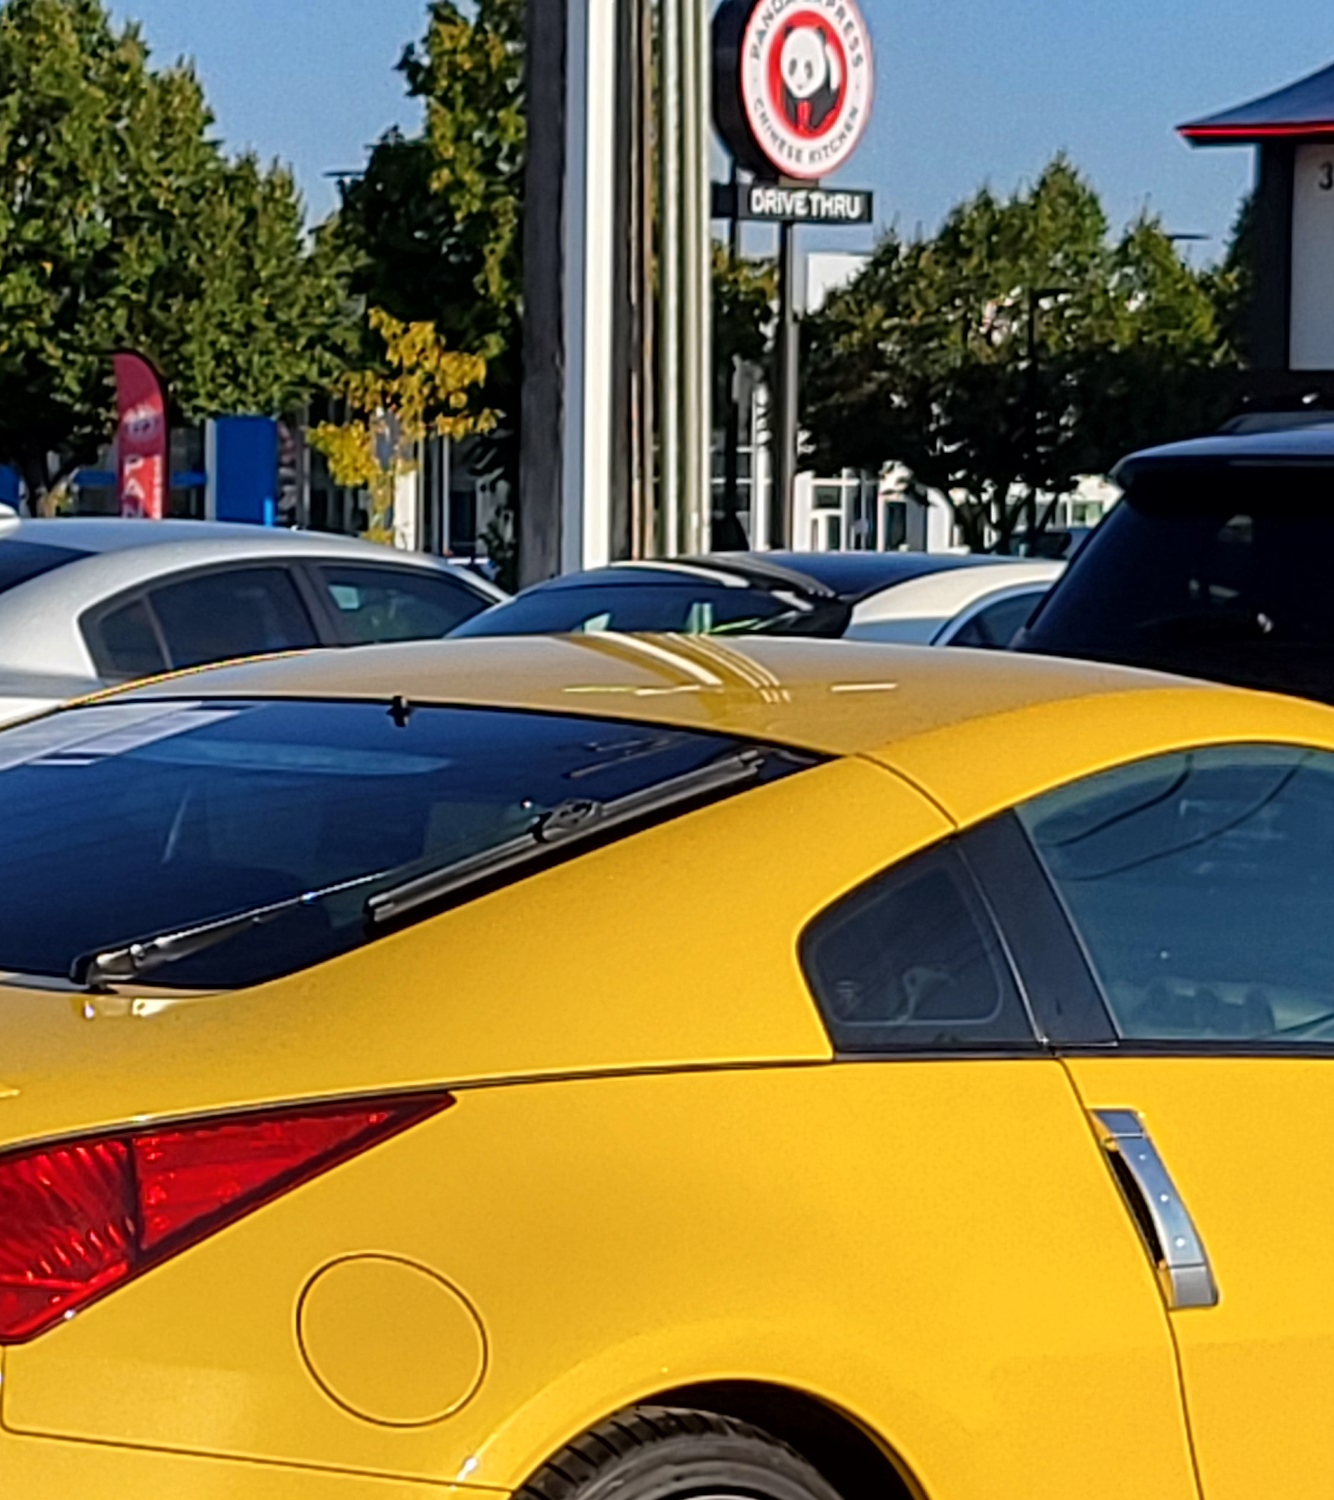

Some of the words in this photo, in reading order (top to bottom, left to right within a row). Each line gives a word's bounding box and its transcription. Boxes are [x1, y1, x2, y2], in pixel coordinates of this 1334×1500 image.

[750, 0, 793, 59] PAND
[753, 97, 803, 164] CHINESE
[808, 106, 859, 164] KITCHEN
[750, 188, 809, 216] DRIVE
[809, 191, 862, 219] THRU
